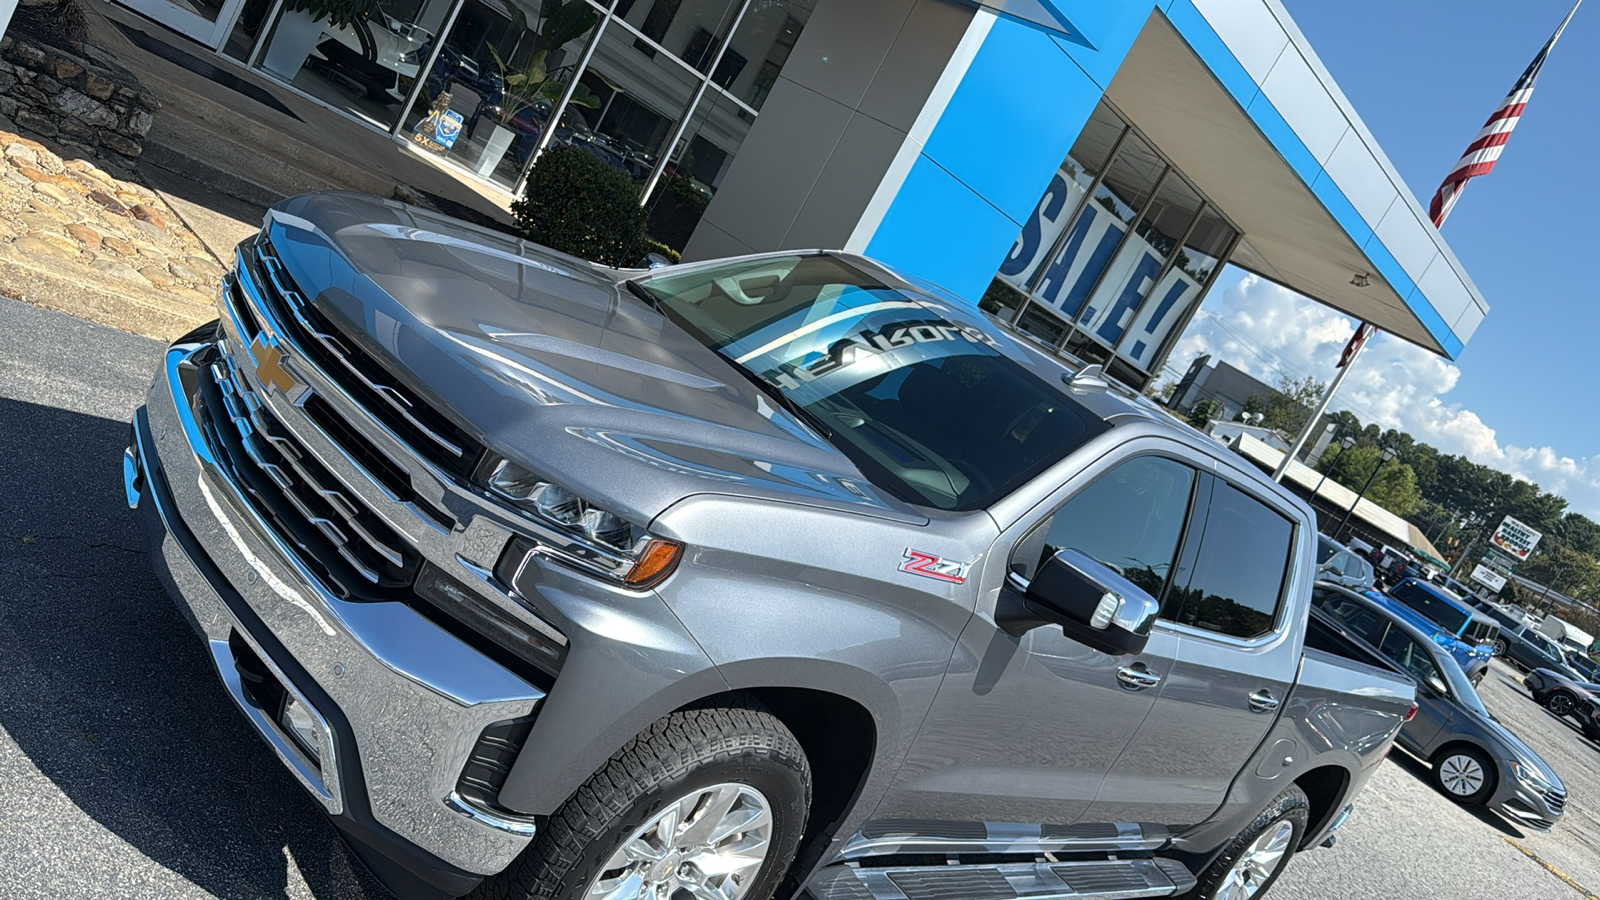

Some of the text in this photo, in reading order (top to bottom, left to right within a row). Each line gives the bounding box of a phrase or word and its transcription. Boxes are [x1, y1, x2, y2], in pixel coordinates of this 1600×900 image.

[998, 173, 1190, 361] SALE!
[1501, 528, 1531, 547] HARVEST
[1502, 521, 1531, 540] HEALTHY
[1500, 534, 1531, 553] PRODUCE
[897, 546, 972, 585] Z71
